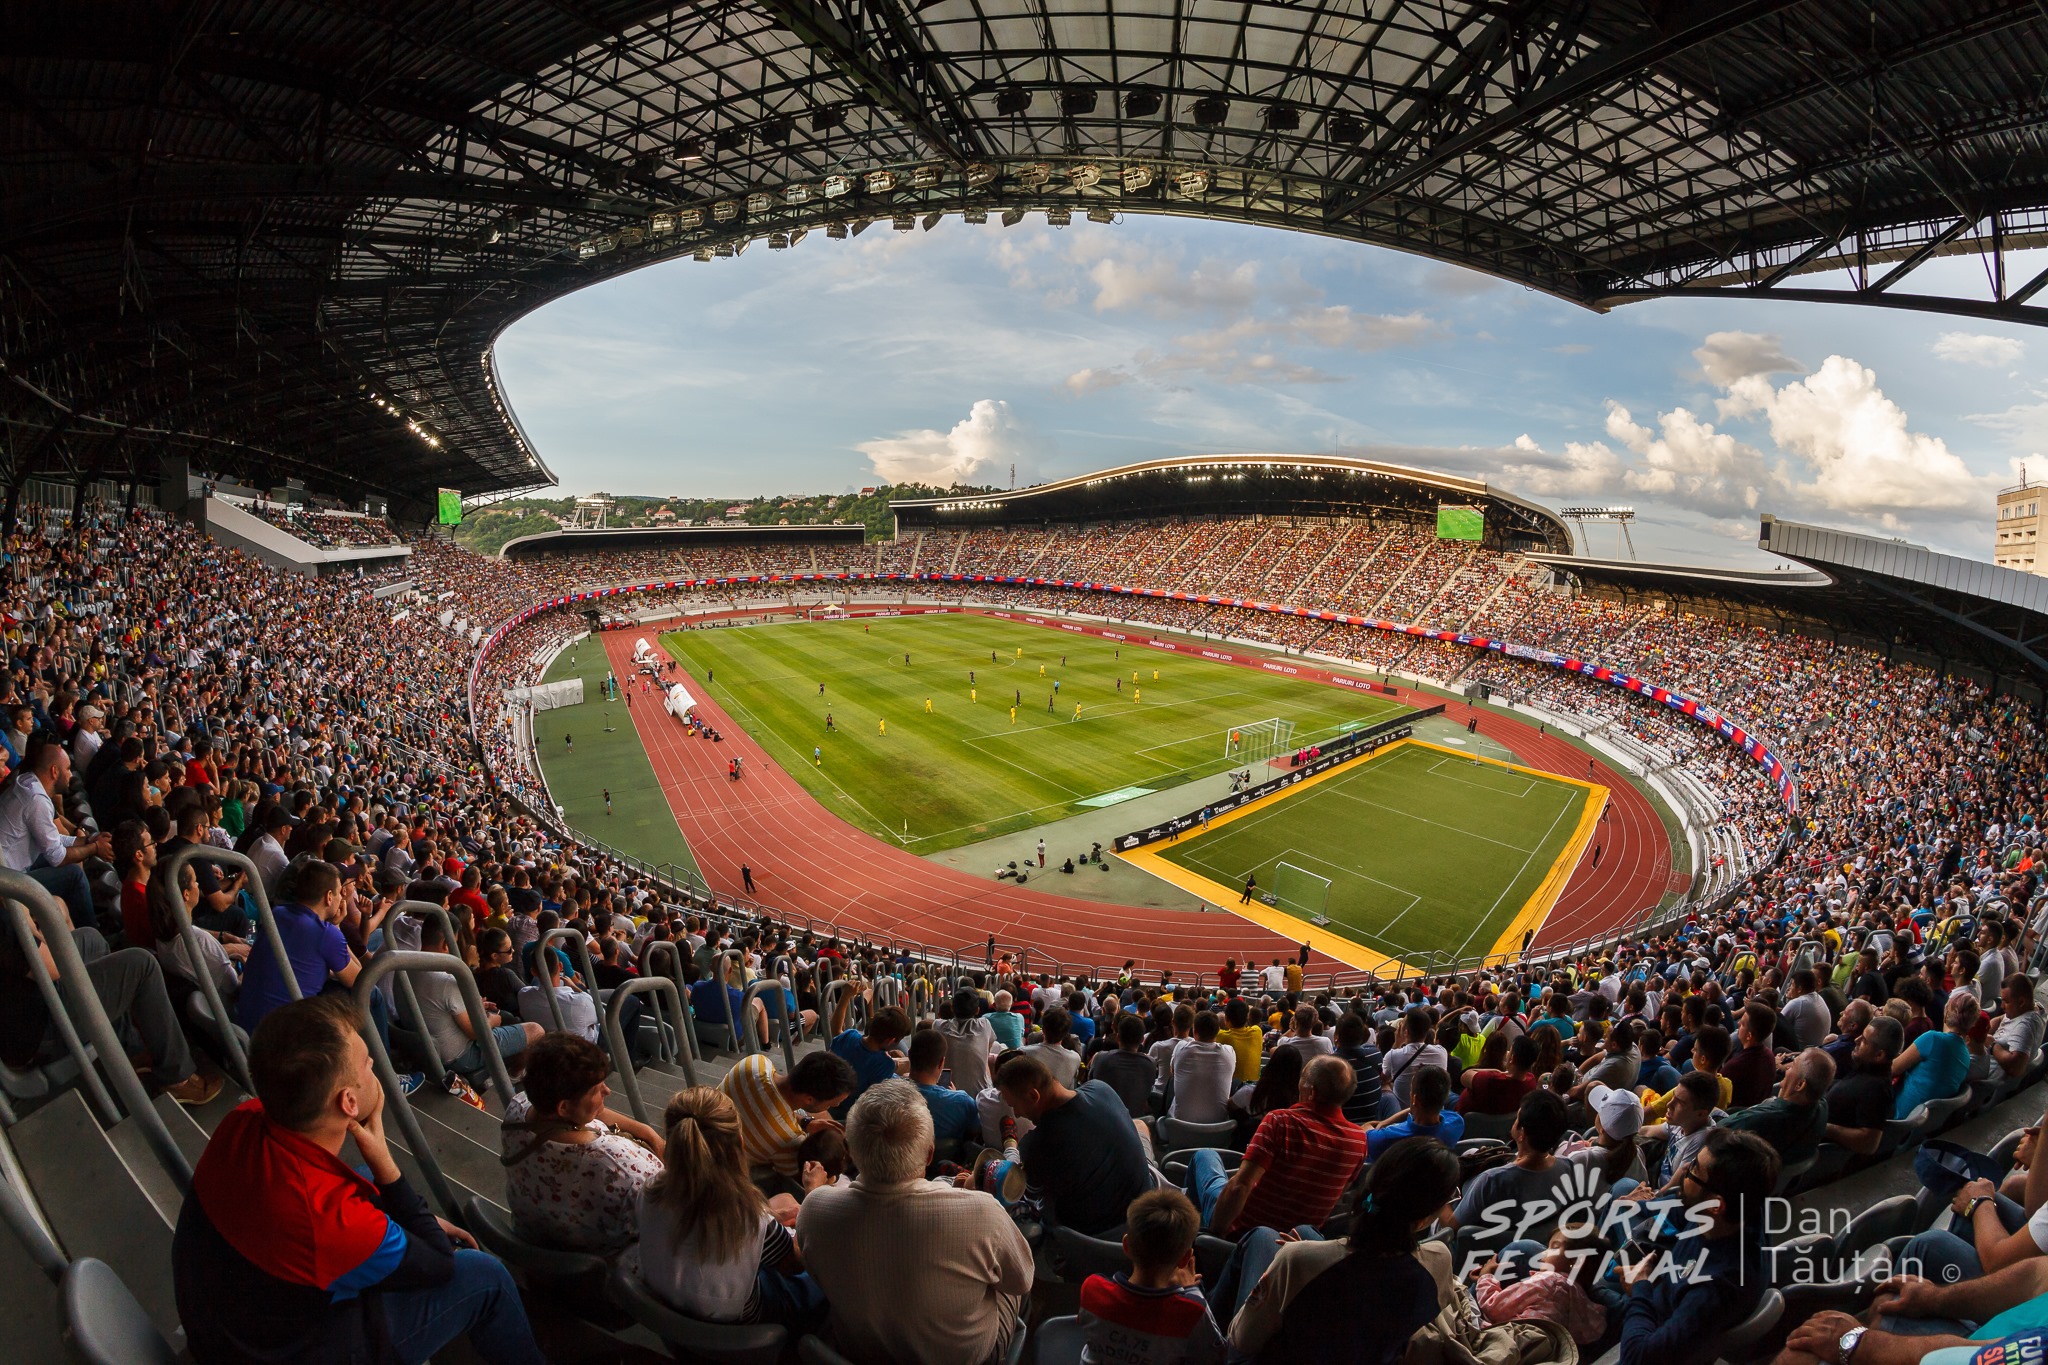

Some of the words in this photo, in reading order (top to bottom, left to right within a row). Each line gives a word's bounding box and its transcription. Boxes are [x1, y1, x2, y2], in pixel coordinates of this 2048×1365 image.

[1202, 650, 1220, 659] PARIURI
[1262, 662, 1283, 672] PARIURI
[1283, 667, 1298, 675] LOTO
[1332, 676, 1355, 687] PARIURI
[1356, 682, 1371, 691] LOTO
